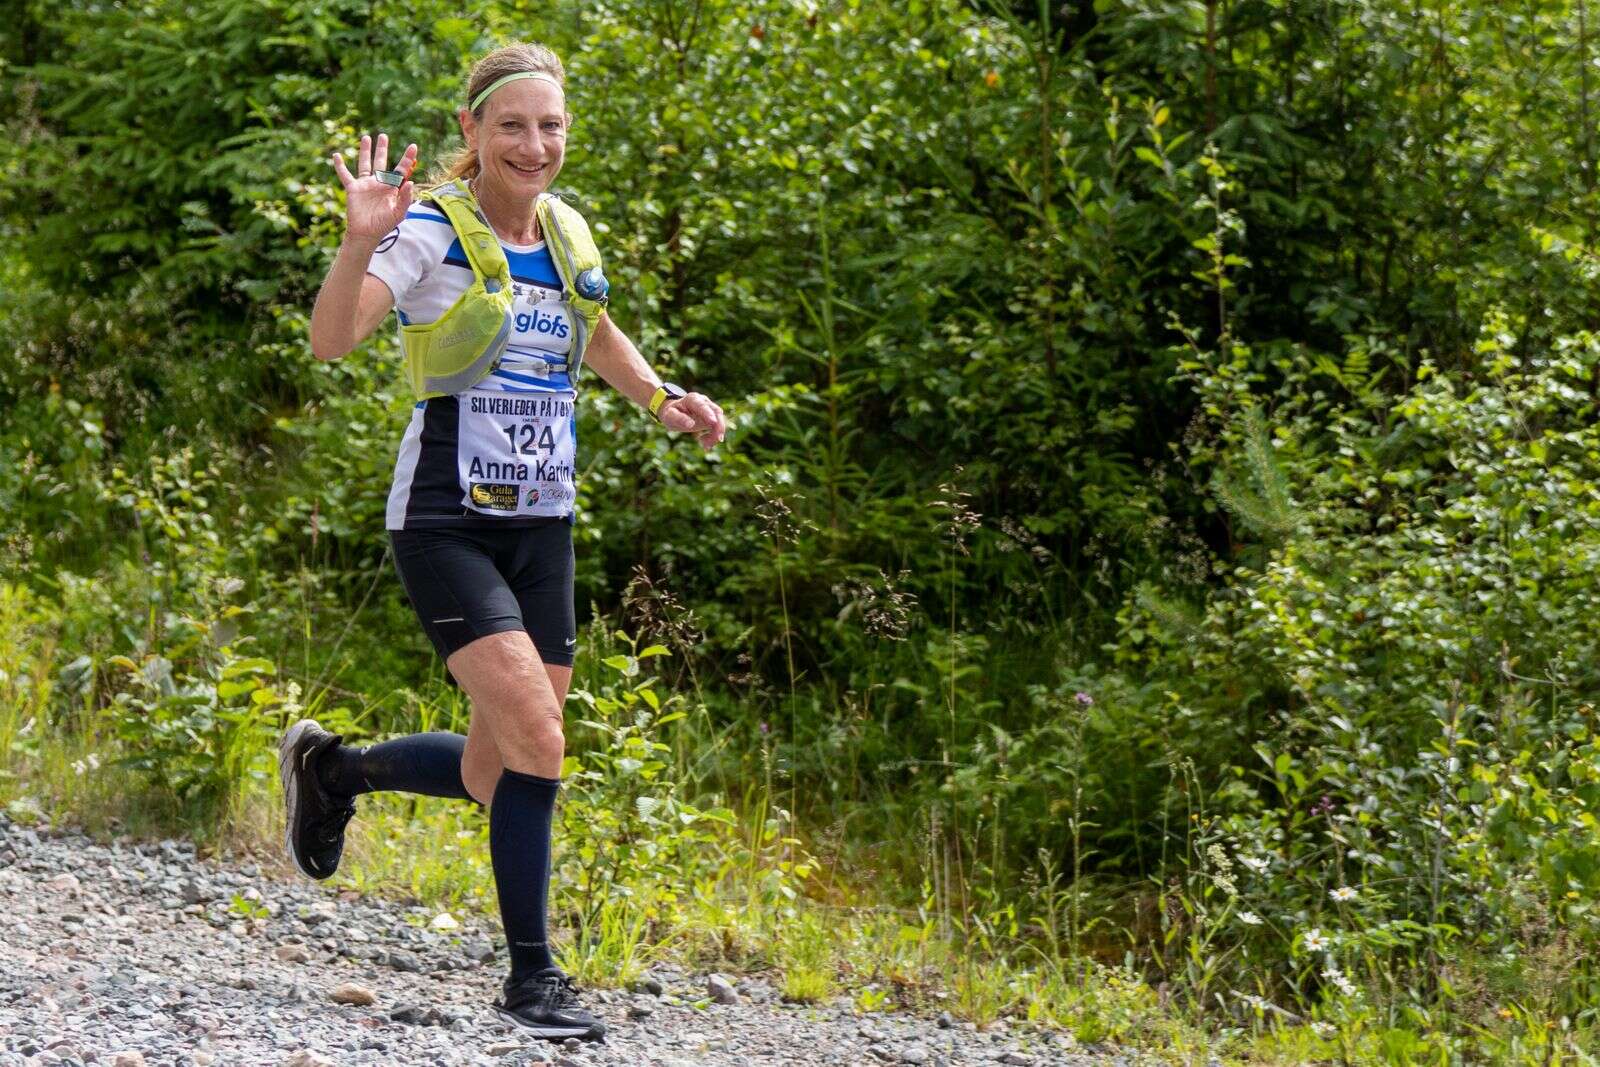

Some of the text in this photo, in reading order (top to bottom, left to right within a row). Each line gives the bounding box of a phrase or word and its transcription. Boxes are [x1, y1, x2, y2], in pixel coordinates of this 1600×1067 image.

[514, 309, 569, 339] glöfs
[471, 396, 537, 416] SILVERLEDEN
[540, 397, 552, 417] PÅ
[503, 424, 556, 456] 124
[468, 456, 570, 482] Anna Karin
